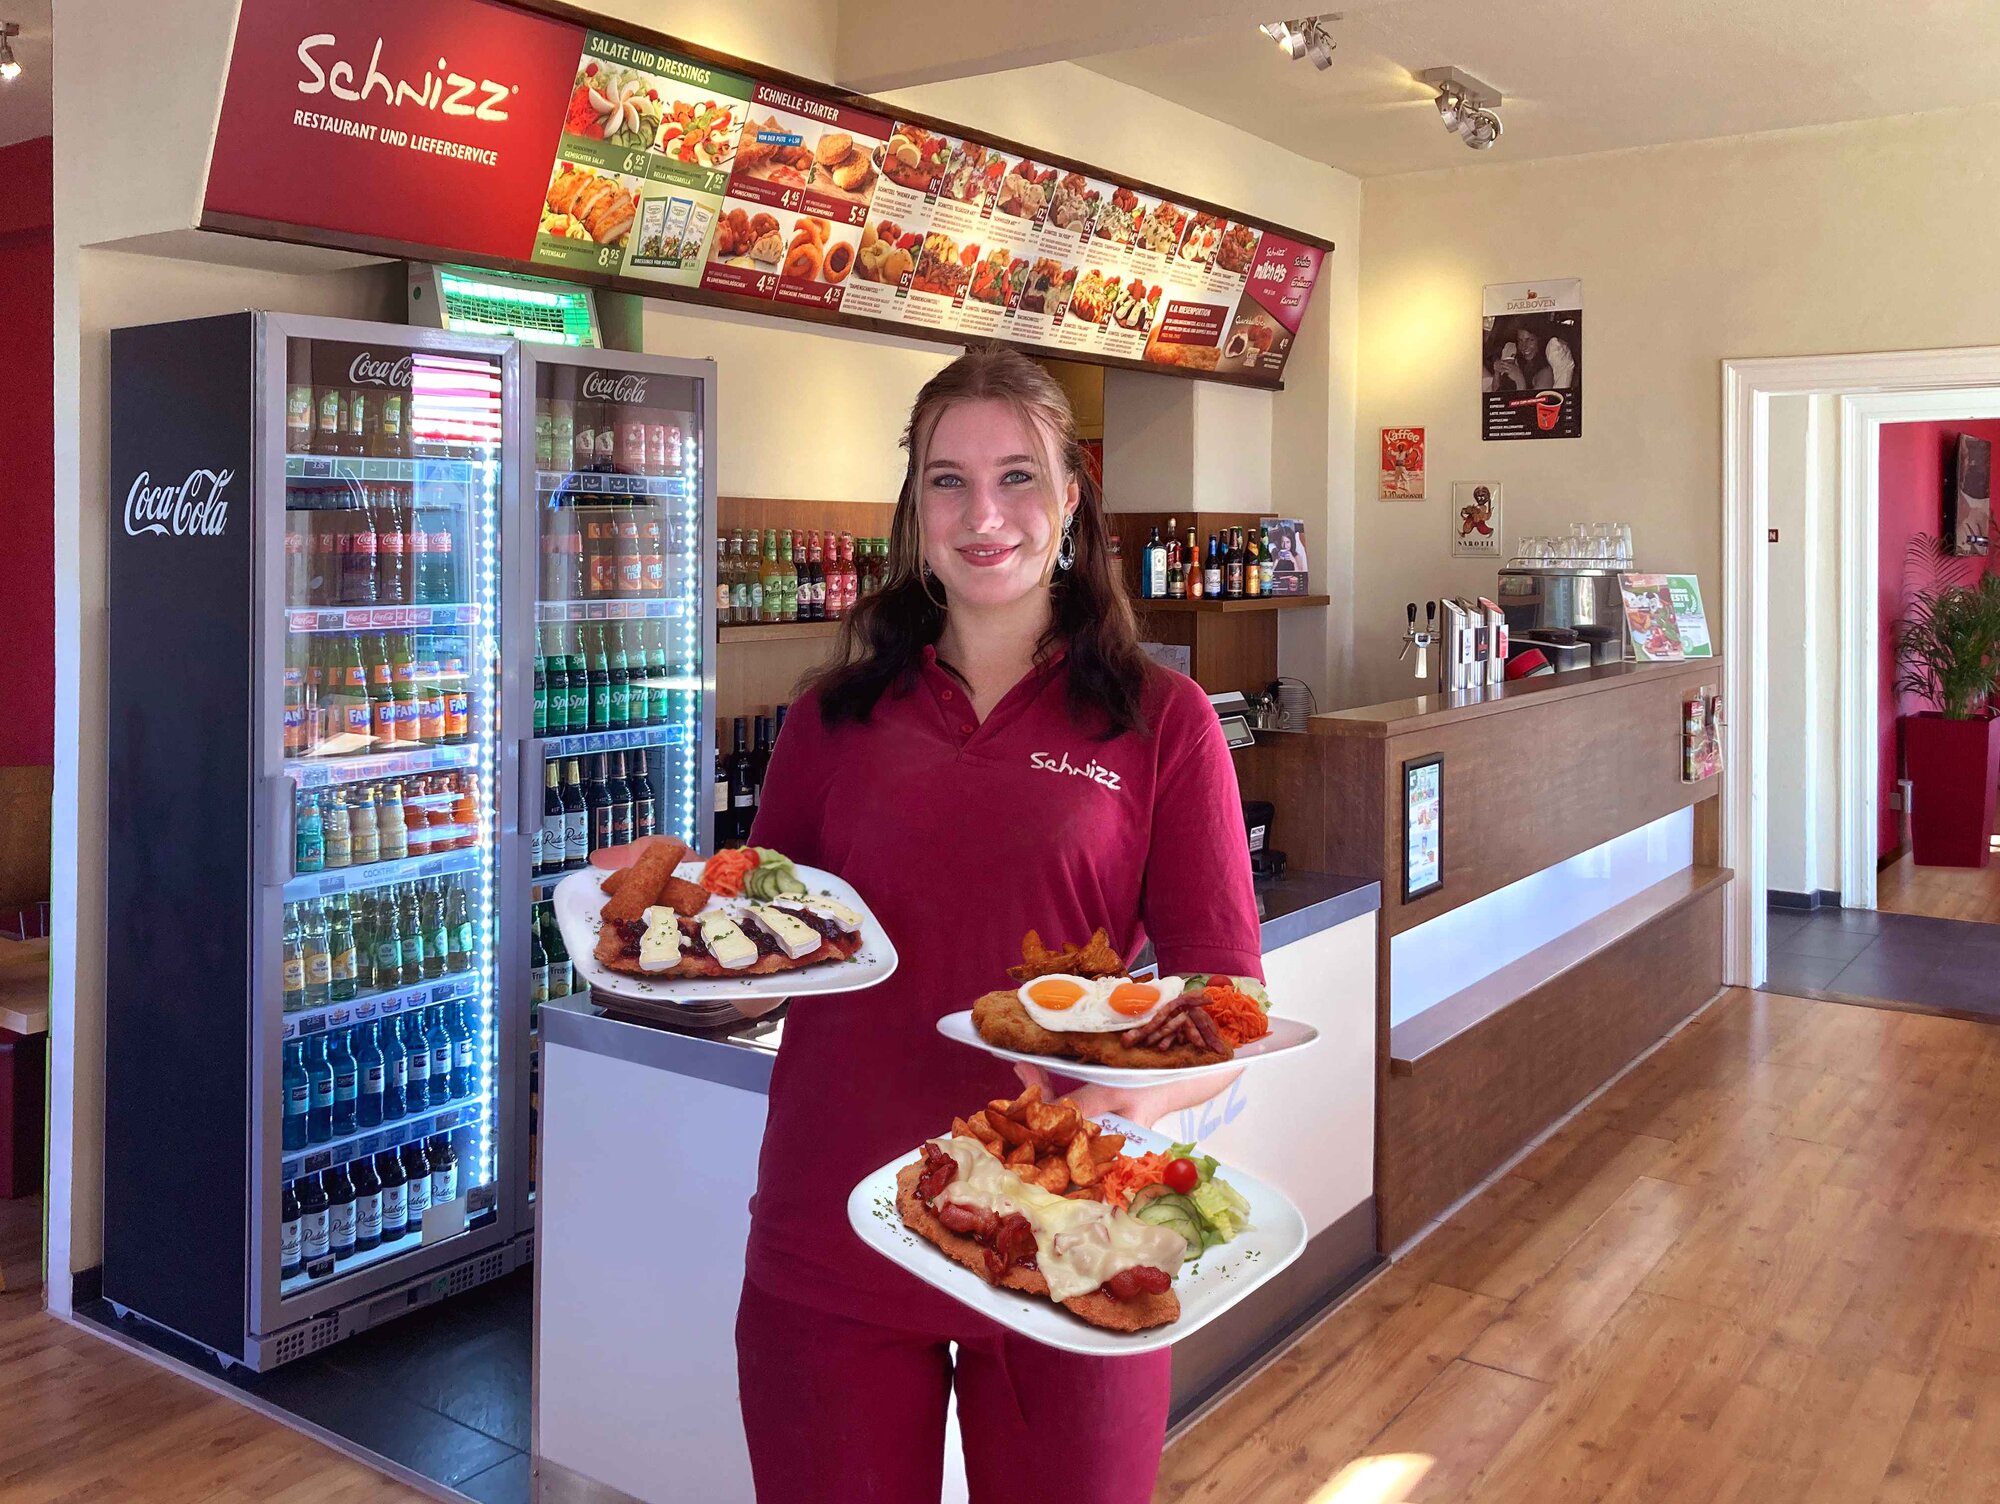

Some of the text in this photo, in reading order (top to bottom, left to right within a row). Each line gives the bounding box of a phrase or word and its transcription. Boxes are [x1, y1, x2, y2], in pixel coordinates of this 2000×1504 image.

[298, 33, 509, 121] Schnizz
[591, 36, 711, 85] SALATE UND DRESSINGS
[758, 86, 839, 122] SCHNELLE STARTER
[293, 109, 498, 166] RESTAURANT UND LIEFERSERVICE
[1507, 299, 1556, 310] DARBOVEN
[349, 352, 414, 387] Coca-Co
[582, 370, 648, 403] Coca-Cola
[1384, 429, 1420, 445] Kaffee
[124, 468, 236, 537] Coca-Cola
[1670, 594, 1690, 602] ESTE
[1030, 751, 1121, 790] Schnizz
